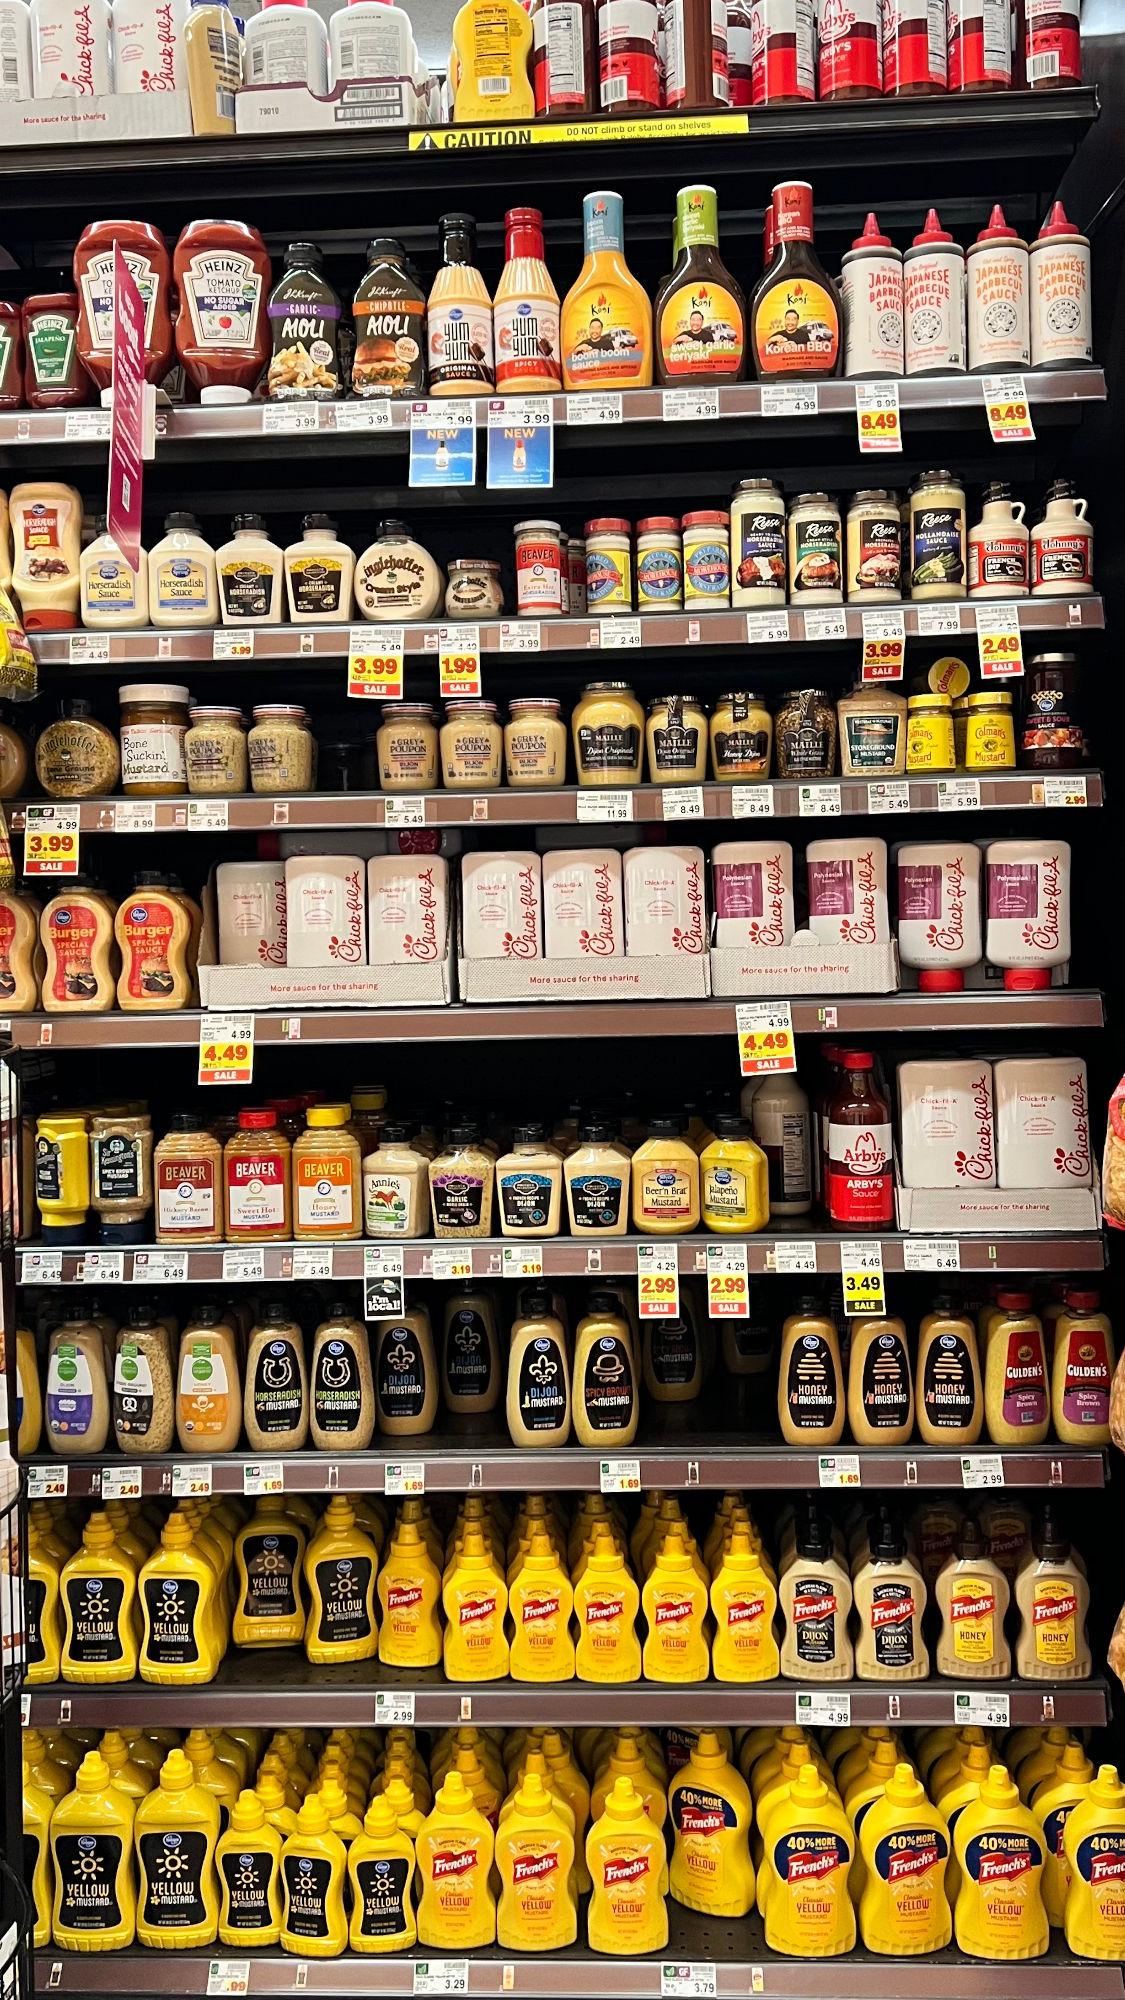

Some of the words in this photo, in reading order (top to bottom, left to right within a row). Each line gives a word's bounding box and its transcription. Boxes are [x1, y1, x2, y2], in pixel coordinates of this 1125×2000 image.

[820, 42, 851, 61] ARBY'S
[259, 108, 279, 116] 79010
[83, 113, 106, 122] sharing
[444, 130, 531, 149] CAUTION
[581, 127, 598, 135] NOT
[601, 125, 624, 134] climb
[638, 124, 662, 132] stand
[678, 121, 711, 130] shelves
[205, 261, 241, 275] HEINZ
[976, 265, 1022, 284] JAPANESE
[206, 279, 241, 287] TOMATO
[977, 279, 1022, 298] BARBECUE
[218, 297, 244, 305] SUGAR
[982, 291, 1017, 305] SAUCE
[37, 321, 63, 331] HEINZ
[282, 318, 324, 338] AIOLI
[367, 315, 409, 335] AIOLI
[35, 335, 66, 344] JALAPEÑO
[671, 342, 703, 351] sweet
[705, 340, 735, 351] garlic
[765, 343, 804, 354] Korean
[807, 342, 831, 354] BBQ
[571, 350, 598, 362] boom
[600, 348, 630, 358] boom
[670, 351, 709, 362] teriyaki
[440, 365, 476, 373] ORIGINAL
[571, 360, 600, 370] sauce
[795, 402, 815, 410] 4.99
[600, 410, 620, 419] 4.99
[990, 405, 1027, 421] 8.49
[296, 417, 316, 427] 3.99
[524, 415, 550, 424] 3.99
[861, 413, 897, 430] 8.49
[427, 429, 459, 439] NEW
[504, 428, 535, 438] NEW
[916, 531, 959, 540] HOLLANDAISE
[985, 541, 1026, 553] Johnny's
[522, 550, 554, 563] BEAVER
[987, 557, 1015, 565] FRENCH
[160, 579, 203, 588] Horseradish
[171, 588, 192, 597] Sauce
[938, 621, 958, 630] 7.99
[768, 630, 788, 639] 5.99
[621, 636, 640, 644] 2.49
[231, 646, 251, 655] 3.99
[866, 643, 902, 658] 3.99
[983, 637, 1019, 654] 2.49
[89, 651, 108, 659] 4.49
[354, 658, 397, 674] 3.99
[442, 658, 476, 674] 1.99
[872, 667, 893, 676] SALE
[364, 684, 387, 694] SALE
[975, 727, 1006, 739] Colman's
[124, 738, 148, 750] Bone
[397, 738, 420, 746] GREY
[791, 740, 824, 749] MAILLE
[390, 745, 426, 753] POUPON
[975, 751, 1006, 761] Mustard
[124, 762, 169, 774] Mustard
[889, 800, 908, 809] 5.49
[1065, 796, 1086, 805] 2.99
[608, 809, 627, 818] 11.99
[750, 804, 770, 813] 8.49
[134, 820, 153, 828] 8.99
[404, 815, 423, 824] 5.49
[30, 836, 74, 852] 3.99
[40, 862, 62, 871] SALE
[124, 925, 172, 937] Burger
[132, 939, 166, 947] SPECIAL
[135, 946, 163, 954] SAUCE
[790, 965, 802, 973] for
[804, 965, 818, 973] the
[820, 964, 849, 975] sharing
[769, 1018, 789, 1027] 4.99
[744, 1032, 788, 1050] 4.49
[204, 1045, 248, 1062] 4.49
[757, 1060, 780, 1069] SALE
[214, 1071, 236, 1080] SALE
[843, 1148, 886, 1164] Arby's
[165, 1166, 206, 1181] BEAVER
[236, 1162, 275, 1177] BEAVER
[304, 1162, 344, 1177] BEAVER
[370, 1178, 400, 1190] Annie's
[846, 1179, 883, 1188] ARBY'S
[710, 1185, 738, 1196] Jalapeño
[852, 1189, 878, 1198] Sauce
[710, 1195, 737, 1205] Mustard
[312, 1204, 337, 1212] Honey
[795, 1261, 814, 1269] 4.49
[937, 1258, 957, 1268] 6.49
[164, 1269, 184, 1278] 6.49
[451, 1265, 470, 1274] 3.19
[641, 1277, 675, 1293] 2.99
[846, 1276, 881, 1291] 3.49
[372, 1296, 389, 1304] I'm
[368, 1300, 400, 1311] local!
[648, 1304, 669, 1312] SALE
[854, 1301, 875, 1310] SALE
[1067, 1362, 1107, 1377] GULDEN'S
[531, 1386, 557, 1396] DIJON
[586, 1387, 605, 1397] SPICY
[607, 1385, 631, 1396] BROWN
[935, 1384, 965, 1395] HONEY
[316, 1390, 360, 1400] HORSERADISH
[935, 1395, 971, 1404] MUSTARD
[1078, 1393, 1097, 1401] Spicy
[324, 1400, 358, 1409] MUSTARD
[531, 1396, 563, 1407] MUSTARD
[598, 1396, 630, 1406] MUSTARD
[1076, 1399, 1100, 1407] Brown
[983, 1475, 1001, 1484] 2.99
[45, 1484, 65, 1494] 2.49
[264, 1481, 282, 1491] 1.69
[389, 1589, 420, 1607] French's
[327, 1599, 362, 1611] YELLOW
[952, 1600, 991, 1617] French's
[656, 1604, 691, 1622] French's
[872, 1603, 912, 1622] French's
[77, 1622, 113, 1633] YELLOW
[85, 1632, 114, 1641] MUSTARD
[881, 1634, 907, 1645] DIJON
[960, 1631, 986, 1641] HONEY
[661, 1639, 687, 1647] YELLOW
[393, 1711, 412, 1721] 2.99
[987, 1713, 1007, 1723] 4.99
[680, 1790, 702, 1805] 40%
[702, 1797, 722, 1808] MORE
[979, 1837, 1007, 1851] 40%
[1008, 1837, 1029, 1848] MORE
[434, 1853, 473, 1872] French's
[981, 1857, 1027, 1877] French's
[151, 1882, 194, 1895] YELLOW
[160, 1895, 195, 1905] MUSTARD
[440, 1896, 469, 1906] YELLOW
[987, 1904, 1021, 1915] YELLOW
[445, 1979, 465, 1989] 3.29
[694, 1983, 714, 1993] 3.79
